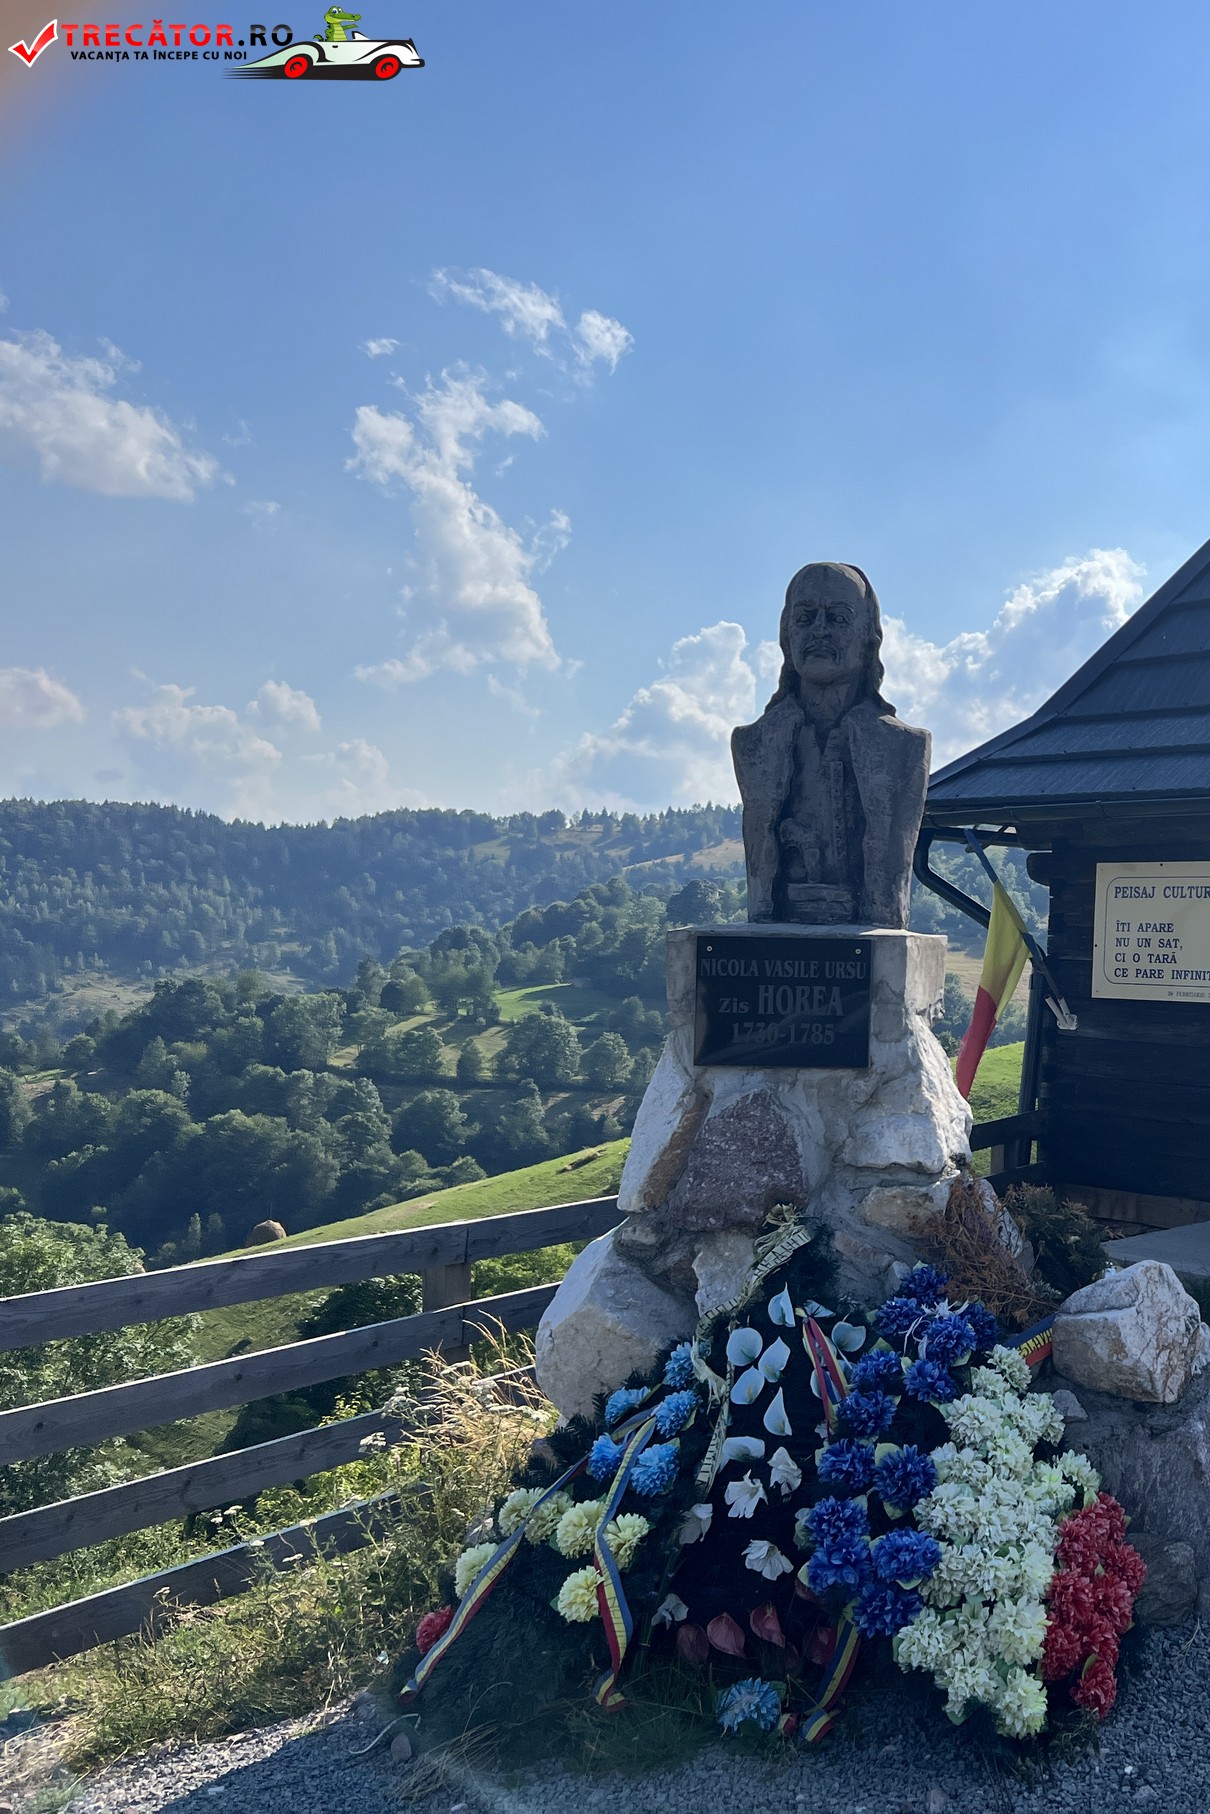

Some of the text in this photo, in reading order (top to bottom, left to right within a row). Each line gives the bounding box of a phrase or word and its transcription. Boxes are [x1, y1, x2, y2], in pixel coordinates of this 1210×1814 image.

[1114, 886, 1156, 899] PEISAJ
[1115, 920, 1175, 933] ÎTI APARE
[1115, 938, 1184, 951] NU UN SAT,
[1114, 953, 1126, 963] CI
[1133, 953, 1141, 963] O
[700, 958, 867, 979] NICOLA VASILE URSU
[1114, 968, 1129, 978] CE
[1135, 969, 1164, 979] PARE
[718, 984, 844, 1017] Zis HOREA
